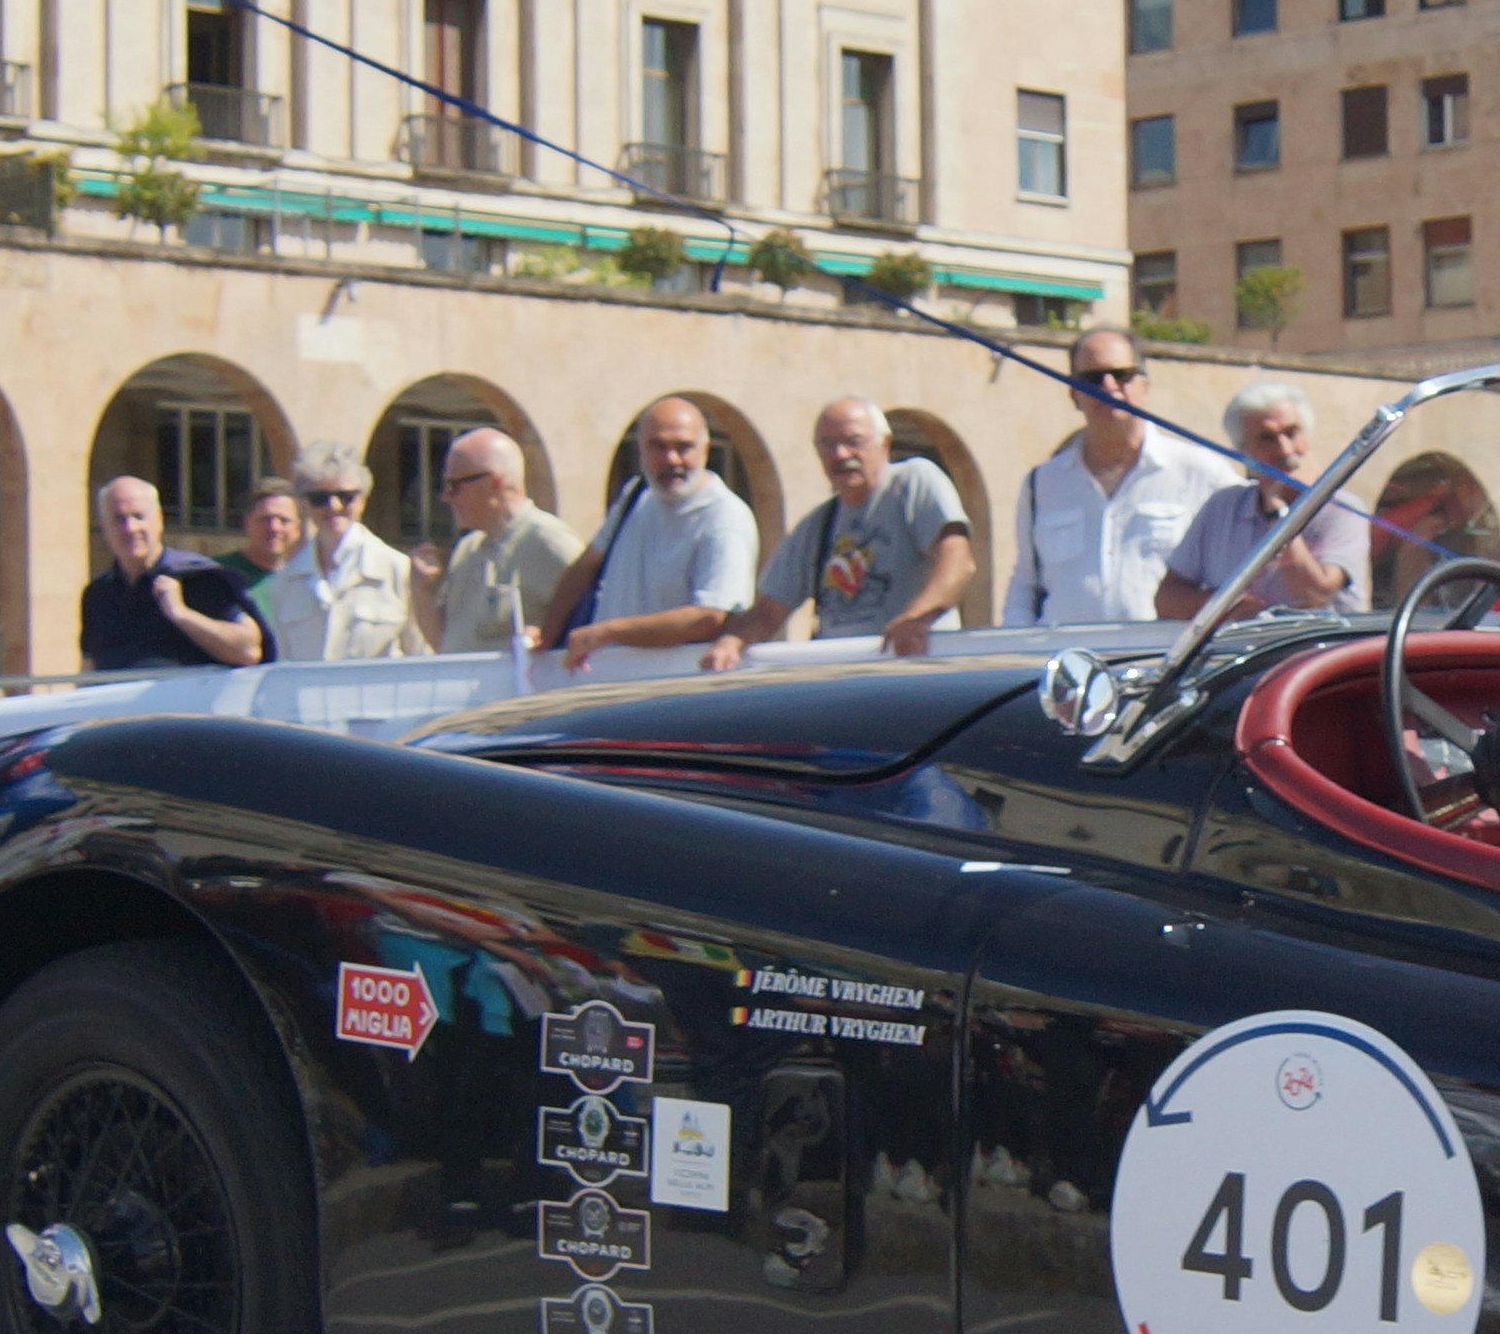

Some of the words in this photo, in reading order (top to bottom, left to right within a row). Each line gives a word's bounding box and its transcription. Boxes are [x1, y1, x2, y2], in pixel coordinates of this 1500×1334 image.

[350, 976, 411, 1007] 1000
[752, 965, 829, 998] JÉRÔME
[831, 979, 925, 1010] VRYGHEM
[345, 1008, 413, 1040] MIGLIA
[748, 1008, 828, 1035] ARTHUR
[830, 1015, 927, 1046] VRYGHEM
[558, 1051, 635, 1074] CHOPARD
[556, 1144, 631, 1166] CHOPARD
[556, 1238, 633, 1260] CHOPARD
[1180, 1171, 1407, 1324] 401
